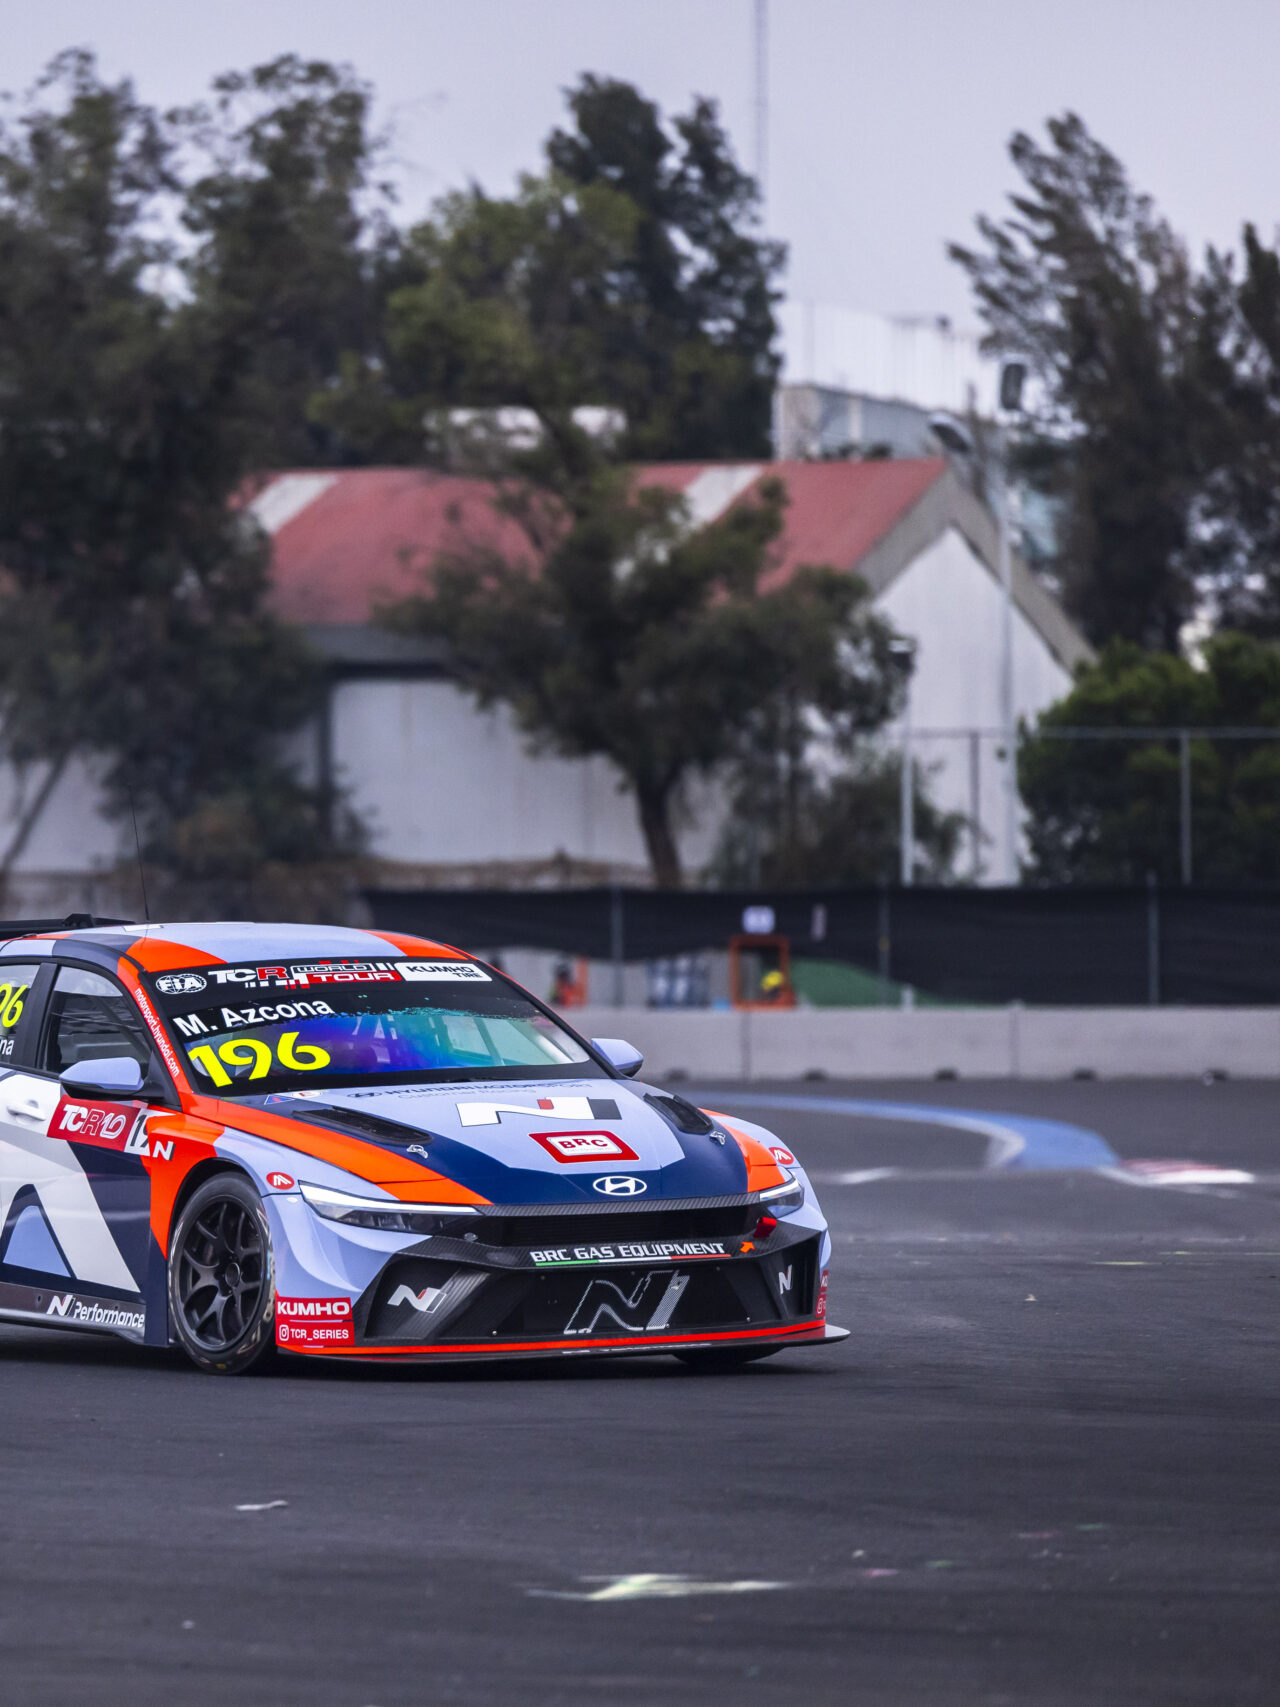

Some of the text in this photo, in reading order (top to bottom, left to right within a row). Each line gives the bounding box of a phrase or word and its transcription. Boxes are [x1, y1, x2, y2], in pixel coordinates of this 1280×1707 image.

[208, 964, 368, 984] TCR WORLD
[313, 972, 395, 982] TOUR
[406, 965, 475, 974] KUMHO
[173, 1000, 335, 1037] M. Azcona
[135, 988, 180, 1077] motorsport.hyundai.com
[187, 1031, 331, 1088] 196
[385, 1085, 475, 1095] HYUNDAI
[558, 1138, 608, 1149] BRC
[529, 1243, 725, 1263] BRC GAS EQUIPMENT
[73, 1301, 146, 1328] Performance
[277, 1301, 350, 1316] KUMHO
[290, 1328, 350, 1341] TCR_SERIES
